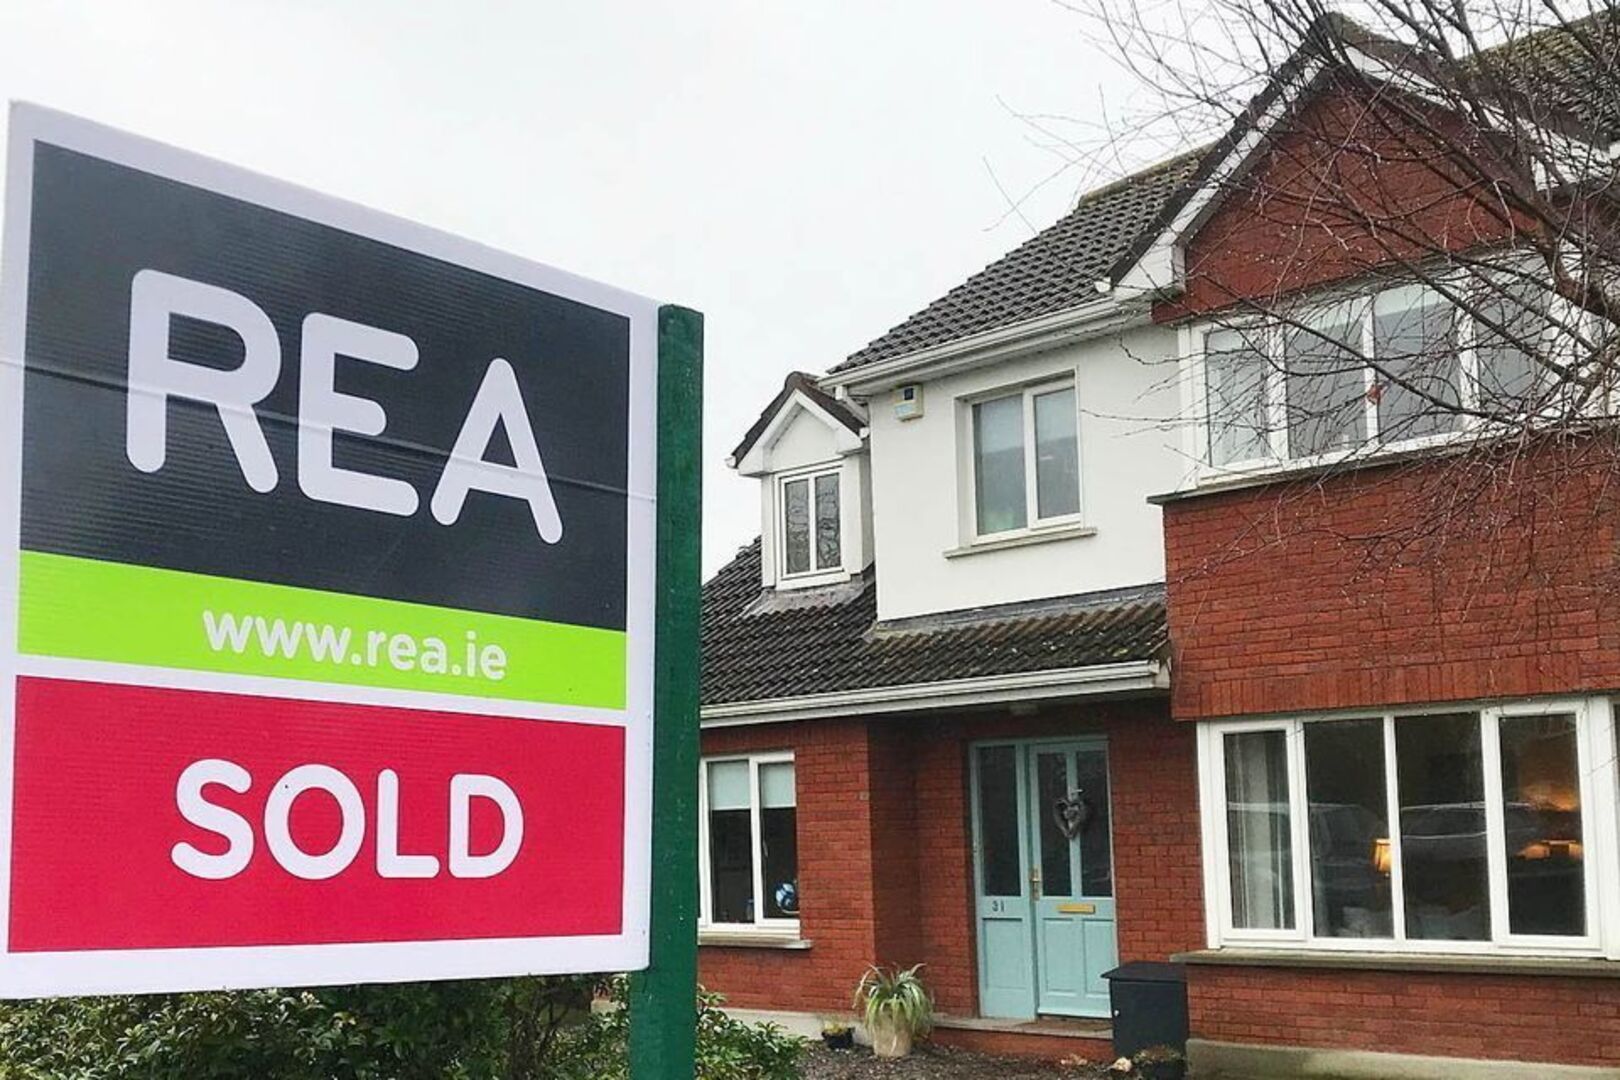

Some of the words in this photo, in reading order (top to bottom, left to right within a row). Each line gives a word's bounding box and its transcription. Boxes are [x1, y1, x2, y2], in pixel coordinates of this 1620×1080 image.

[126, 270, 563, 544] REA
[203, 610, 508, 680] www.rea.ie
[171, 759, 525, 880] SOLD
[992, 900, 1005, 912] 31
